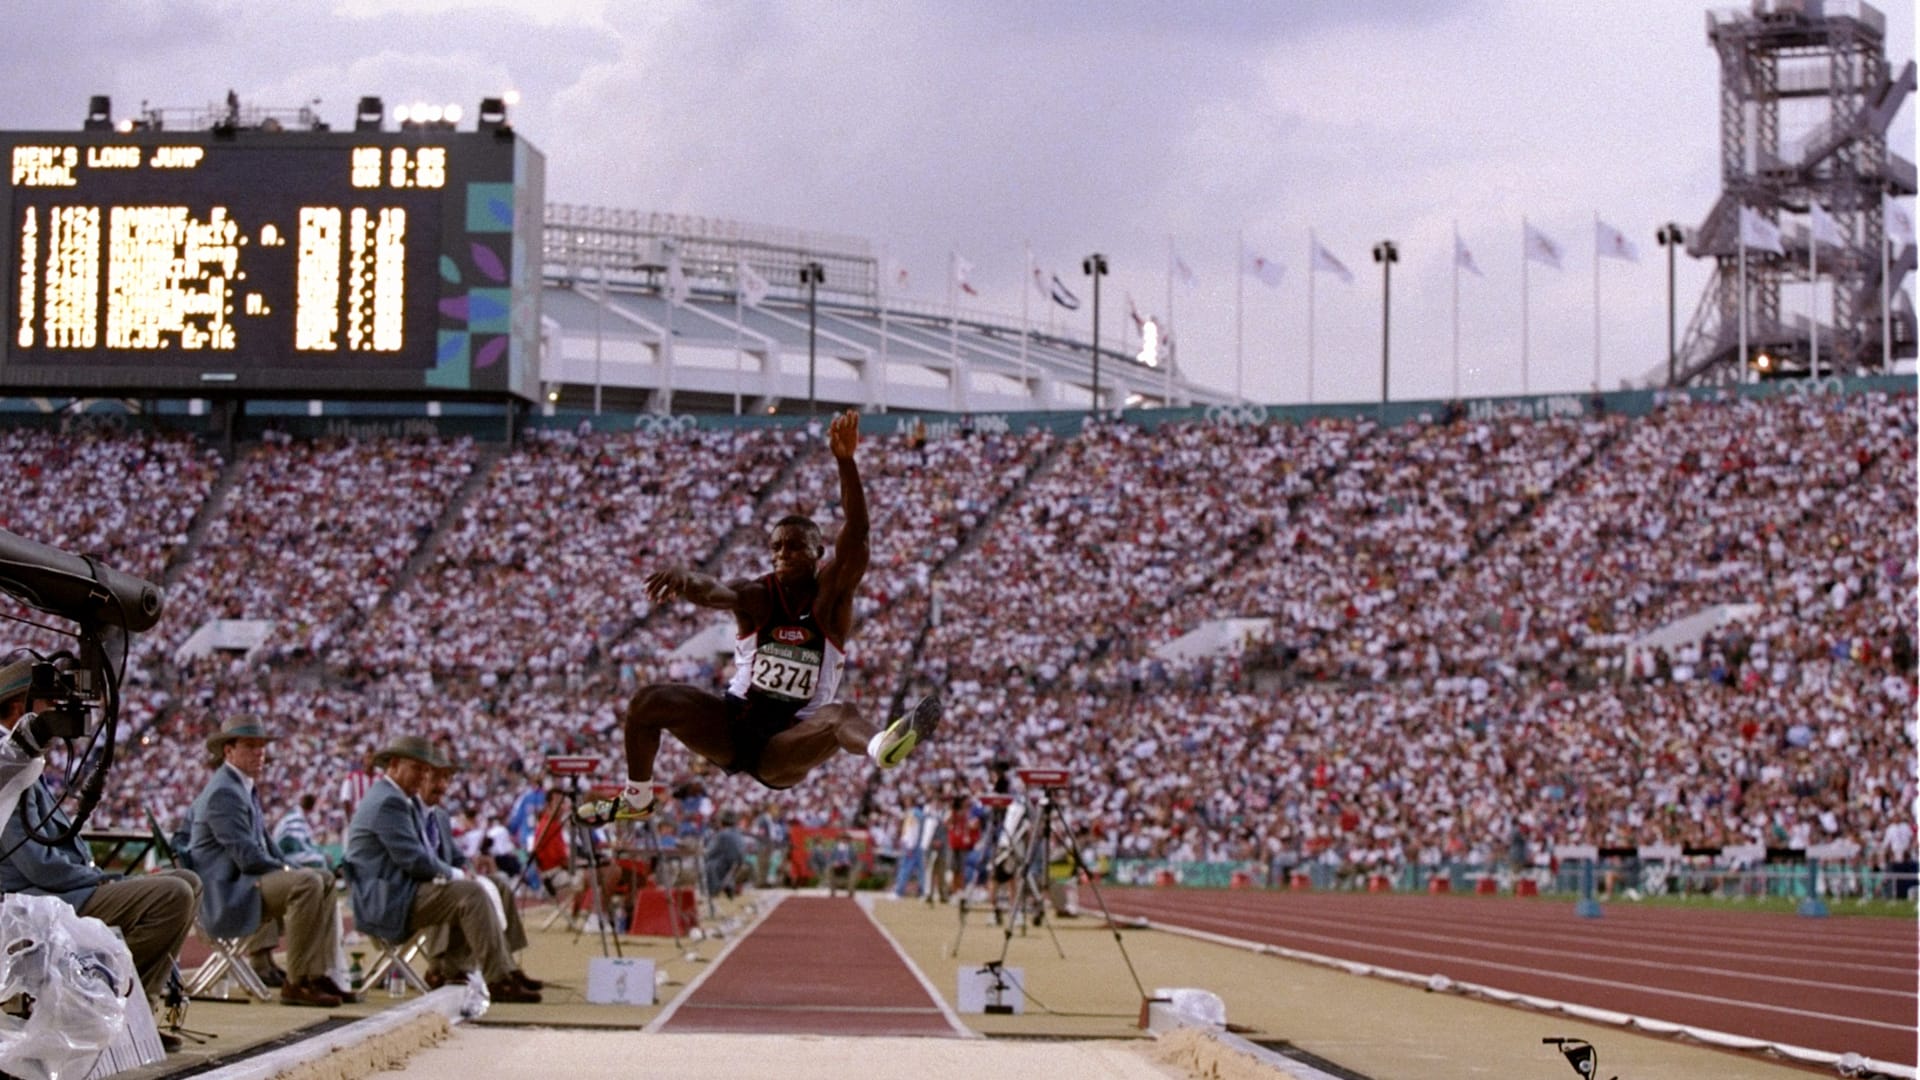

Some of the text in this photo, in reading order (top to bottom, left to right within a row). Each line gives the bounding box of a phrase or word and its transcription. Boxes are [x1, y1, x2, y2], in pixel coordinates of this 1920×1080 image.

[12, 146, 204, 168] MEN'S LONG JUMP
[12, 166, 77, 187] FINAL
[778, 629, 805, 641] USA
[756, 658, 813, 697] 2374
